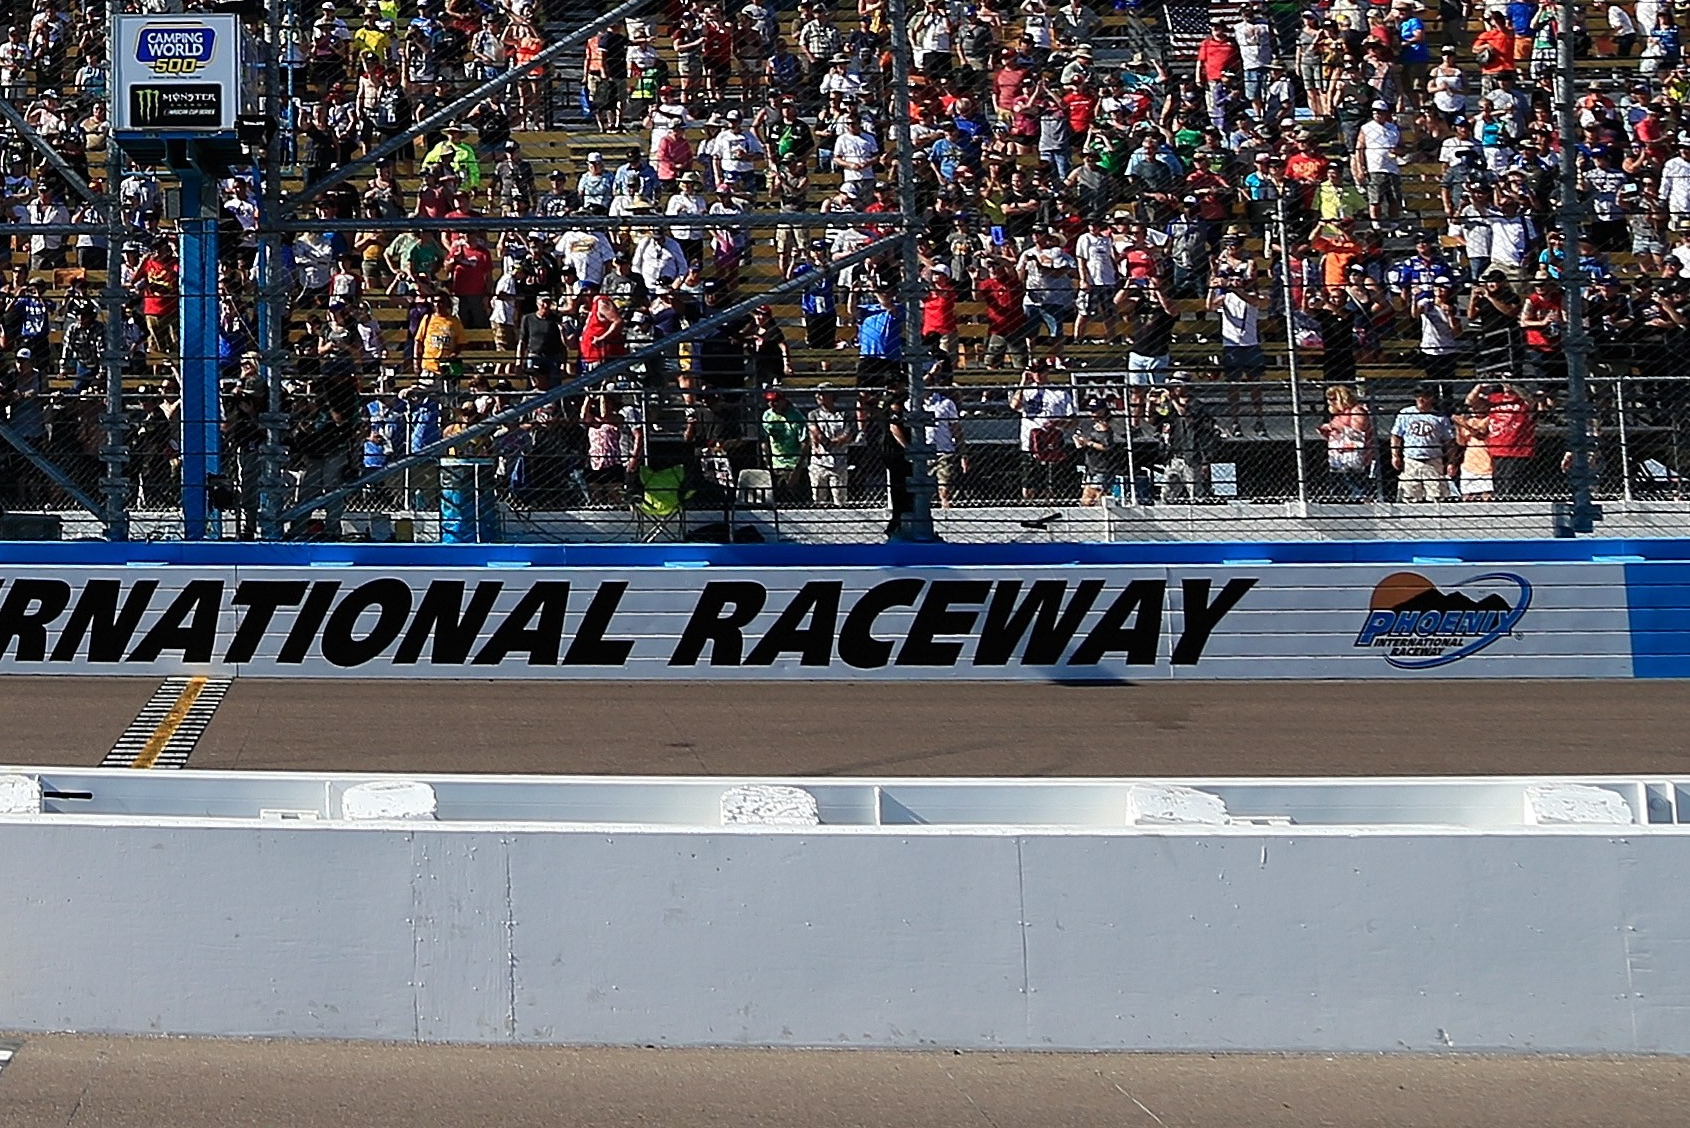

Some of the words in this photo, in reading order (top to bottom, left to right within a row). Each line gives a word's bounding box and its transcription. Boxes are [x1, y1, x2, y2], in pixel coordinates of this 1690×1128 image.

[147, 32, 203, 44] CAMPING
[148, 43, 203, 56] WORLD
[154, 58, 197, 74] 500
[162, 92, 216, 102] MONSTER
[670, 577, 1259, 669] RACEWAY
[1354, 609, 1523, 648] PHOENIX
[1374, 637, 1464, 648] INTERNATIONAL
[1390, 647, 1446, 657] RACEWAY
